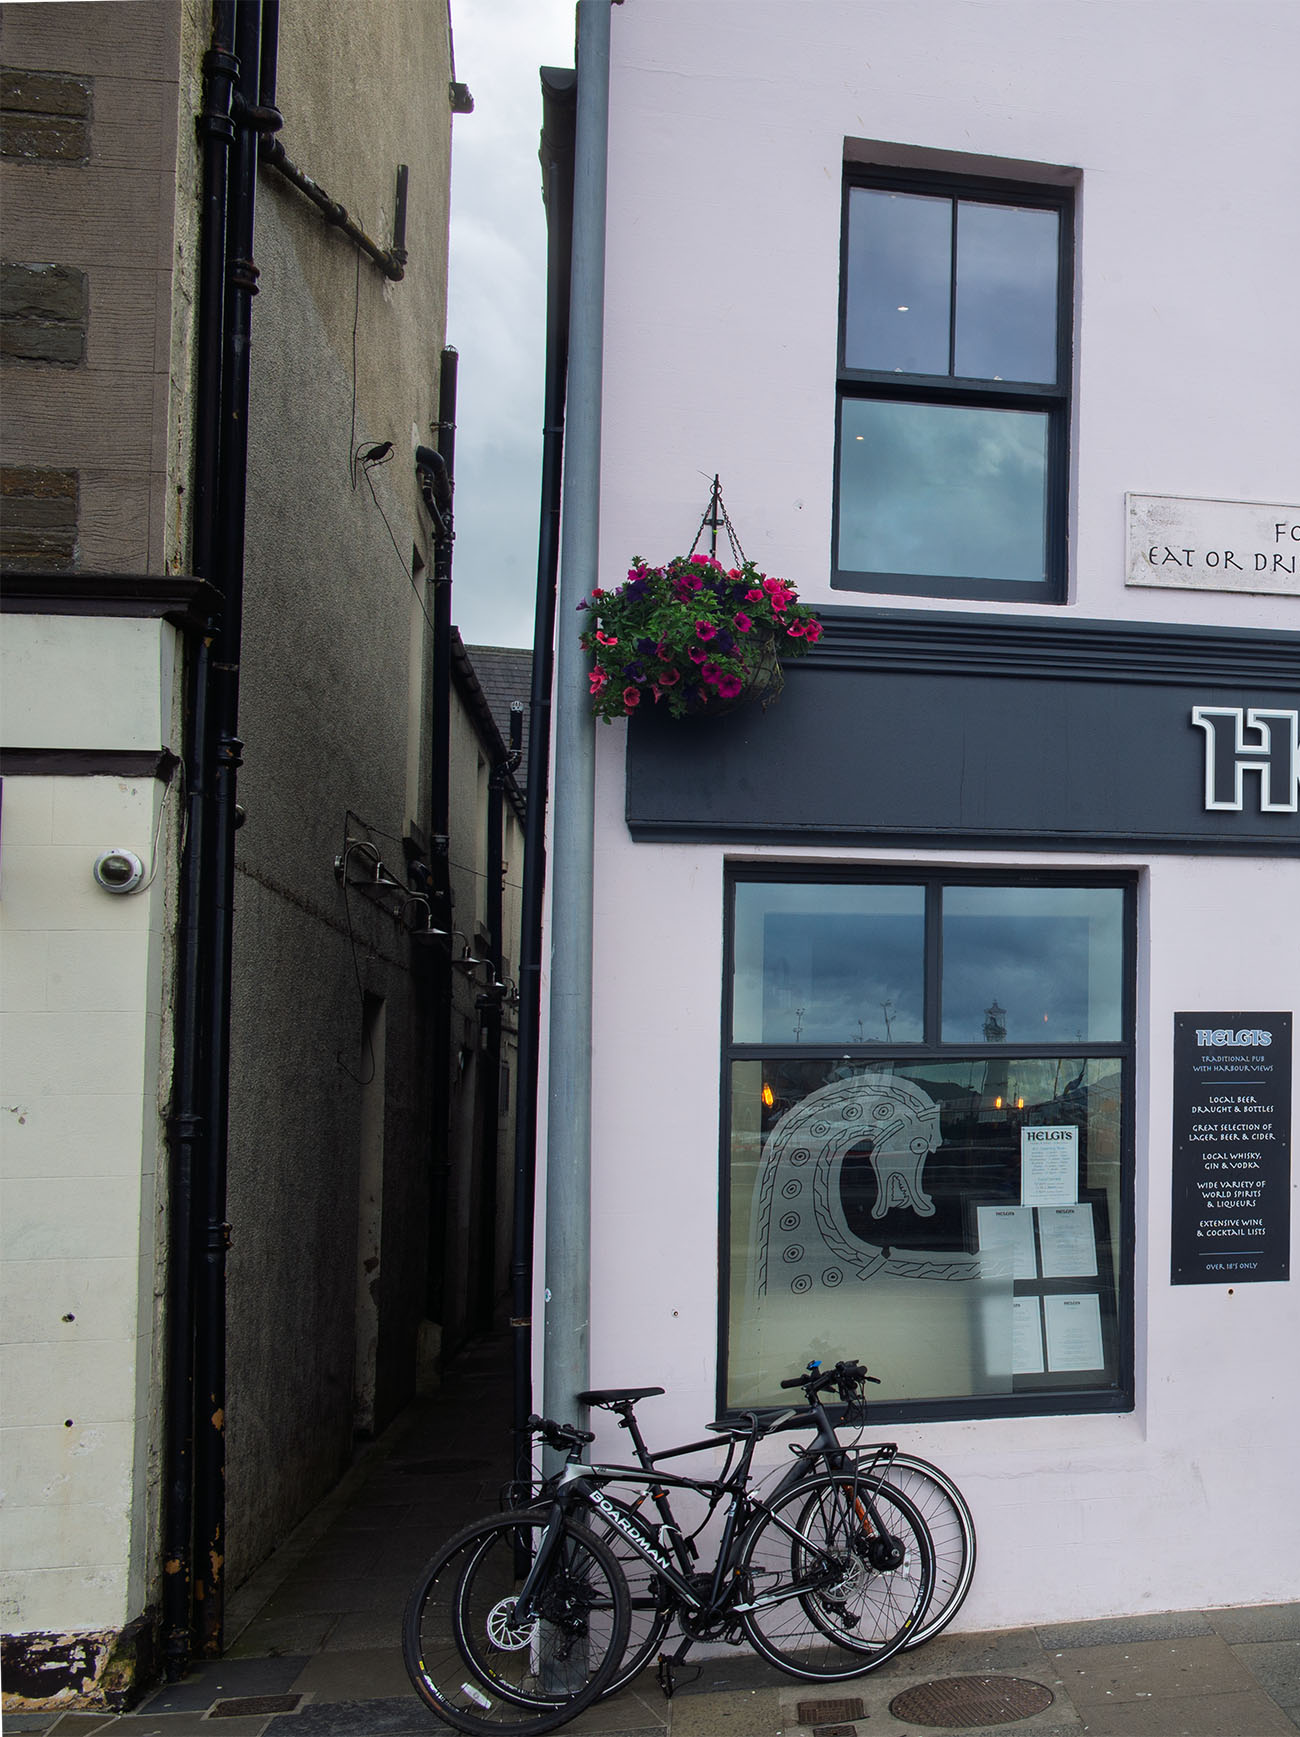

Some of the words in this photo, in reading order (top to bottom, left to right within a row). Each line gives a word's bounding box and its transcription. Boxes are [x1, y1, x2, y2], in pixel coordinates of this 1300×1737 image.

[1148, 546, 1196, 566] EAT
[1205, 550, 1243, 570] OR
[1209, 1096, 1235, 1104] LOCAL
[1027, 1131, 1072, 1141] HELGI'S
[1221, 1133, 1241, 1141] BEER
[1197, 1181, 1218, 1189] WIDE
[1217, 1200, 1256, 1208] LIQUEURS
[1200, 1219, 1239, 1227] EXTENSIVE
[589, 1490, 670, 1569] BOARDMAN
